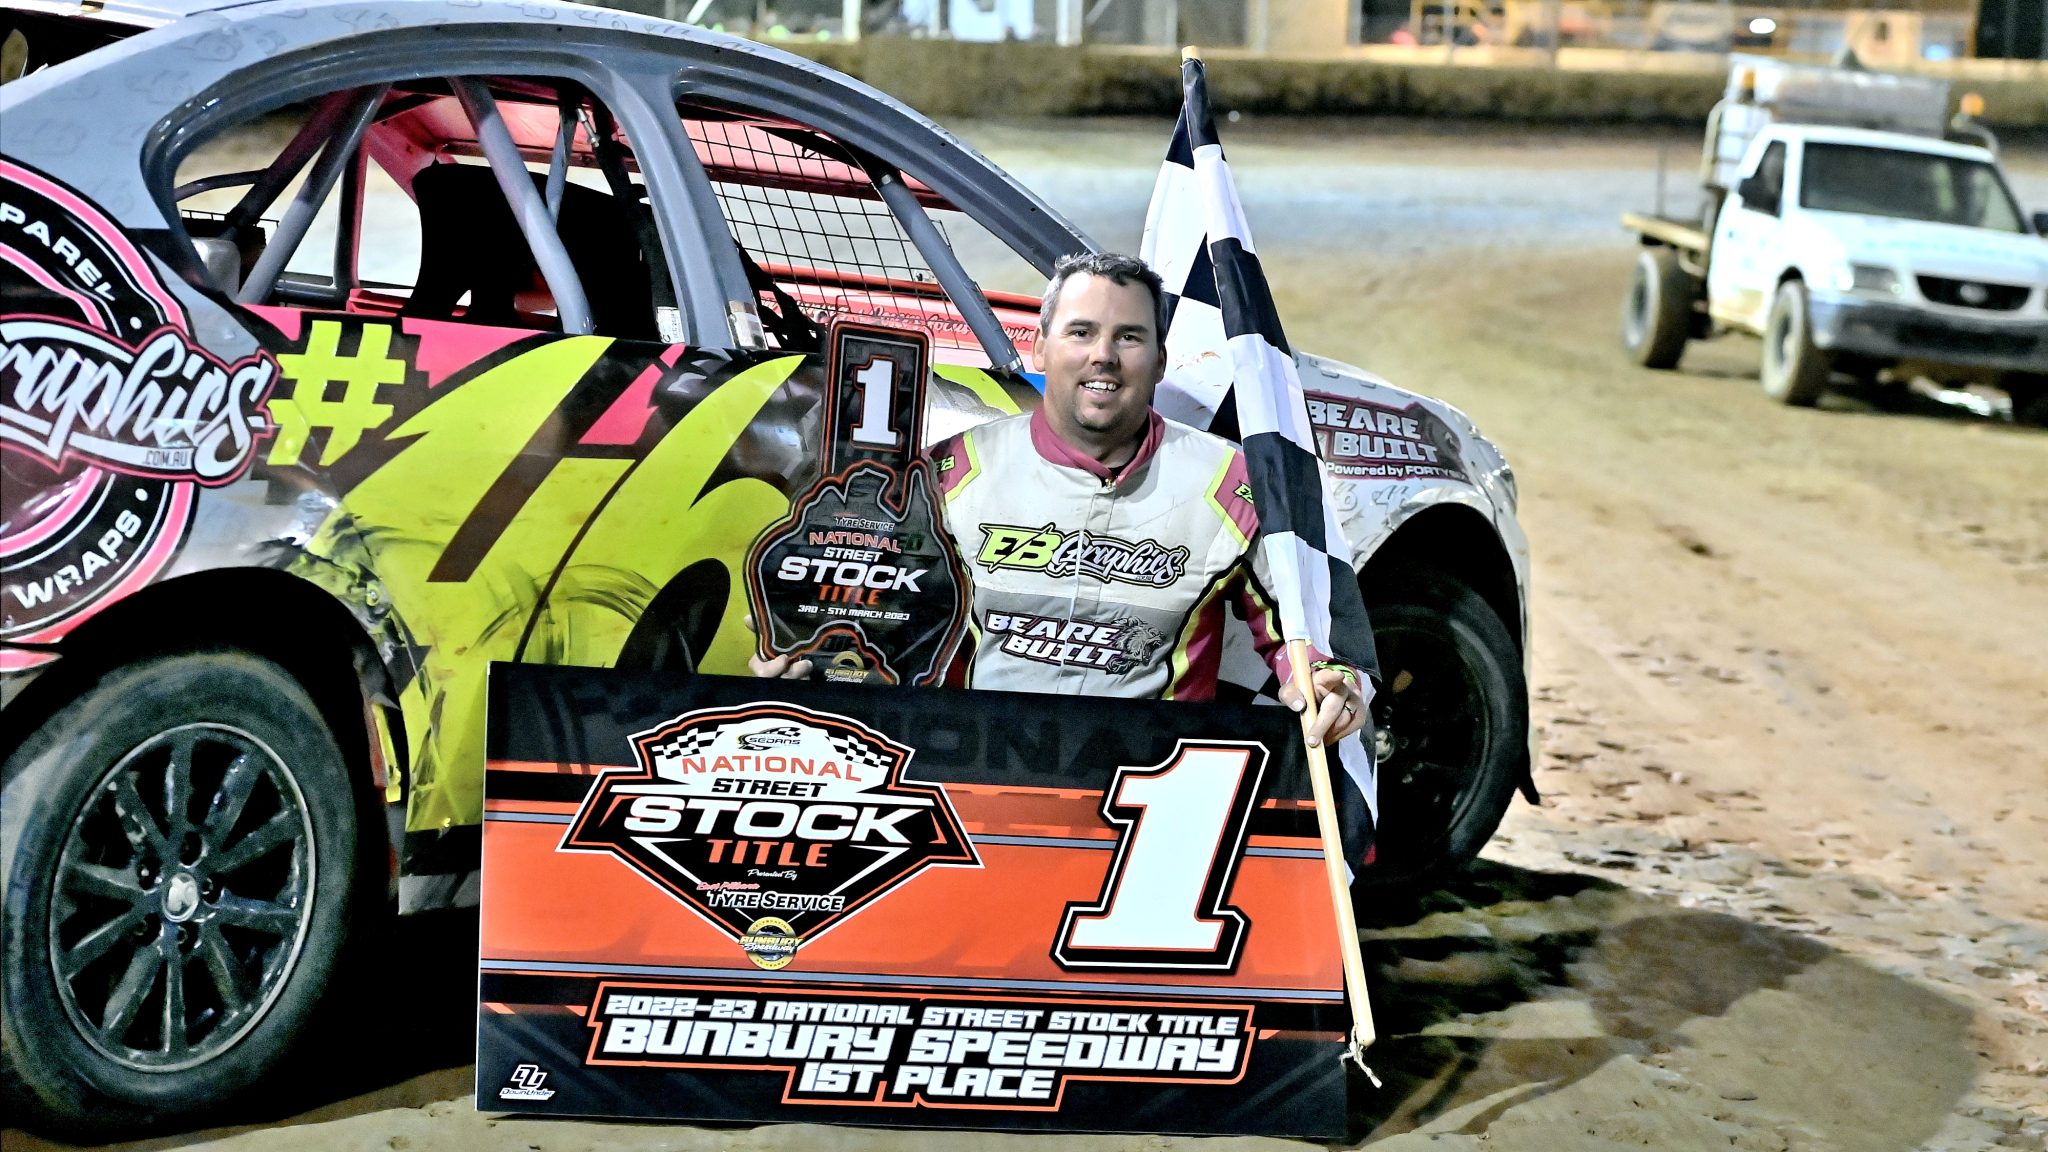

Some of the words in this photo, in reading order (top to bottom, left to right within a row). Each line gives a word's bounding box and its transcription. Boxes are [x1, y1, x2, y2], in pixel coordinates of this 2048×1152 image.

[0, 202, 115, 301] PAREL
[853, 360, 897, 446] 1
[1309, 400, 1421, 440] BEARE
[1334, 432, 1437, 463] BUILT
[1326, 462, 1386, 476] Powered
[1388, 465, 1404, 477] by
[860, 518, 895, 532] SERVICE
[809, 531, 902, 553] NATIONAL
[823, 546, 884, 562] STREET
[978, 525, 1061, 569] EB
[10, 509, 142, 609] WRAPS
[778, 557, 928, 593] STOCK
[819, 585, 882, 605] TITLE
[798, 604, 819, 614] 3RD
[848, 608, 883, 619] MARCH
[884, 613, 911, 621] 2023
[988, 613, 1120, 645] BEARE
[1004, 634, 1121, 665] BUILT
[748, 737, 801, 745] SEDANS
[682, 755, 862, 782] NATIONAL
[711, 778, 828, 798] STREET
[624, 796, 925, 844] STOCK
[706, 839, 833, 867] TITLE
[1066, 747, 1251, 953] 1
[707, 890, 761, 909] TYRE
[761, 891, 845, 912] SERVICE
[739, 935, 805, 947] BUNBURY
[744, 943, 795, 953] Speedway
[604, 994, 757, 1020] 2022-23
[761, 1000, 915, 1025] NATIONAL
[921, 1006, 1045, 1030] STREET
[1048, 1010, 1153, 1034] STOCK
[1156, 1014, 1241, 1036] TITLE
[602, 1018, 897, 1061] BUNBURY
[906, 1029, 1242, 1073] SPEEDWAY
[798, 1062, 886, 1094] 1ST
[892, 1066, 1057, 1099] PLACE
